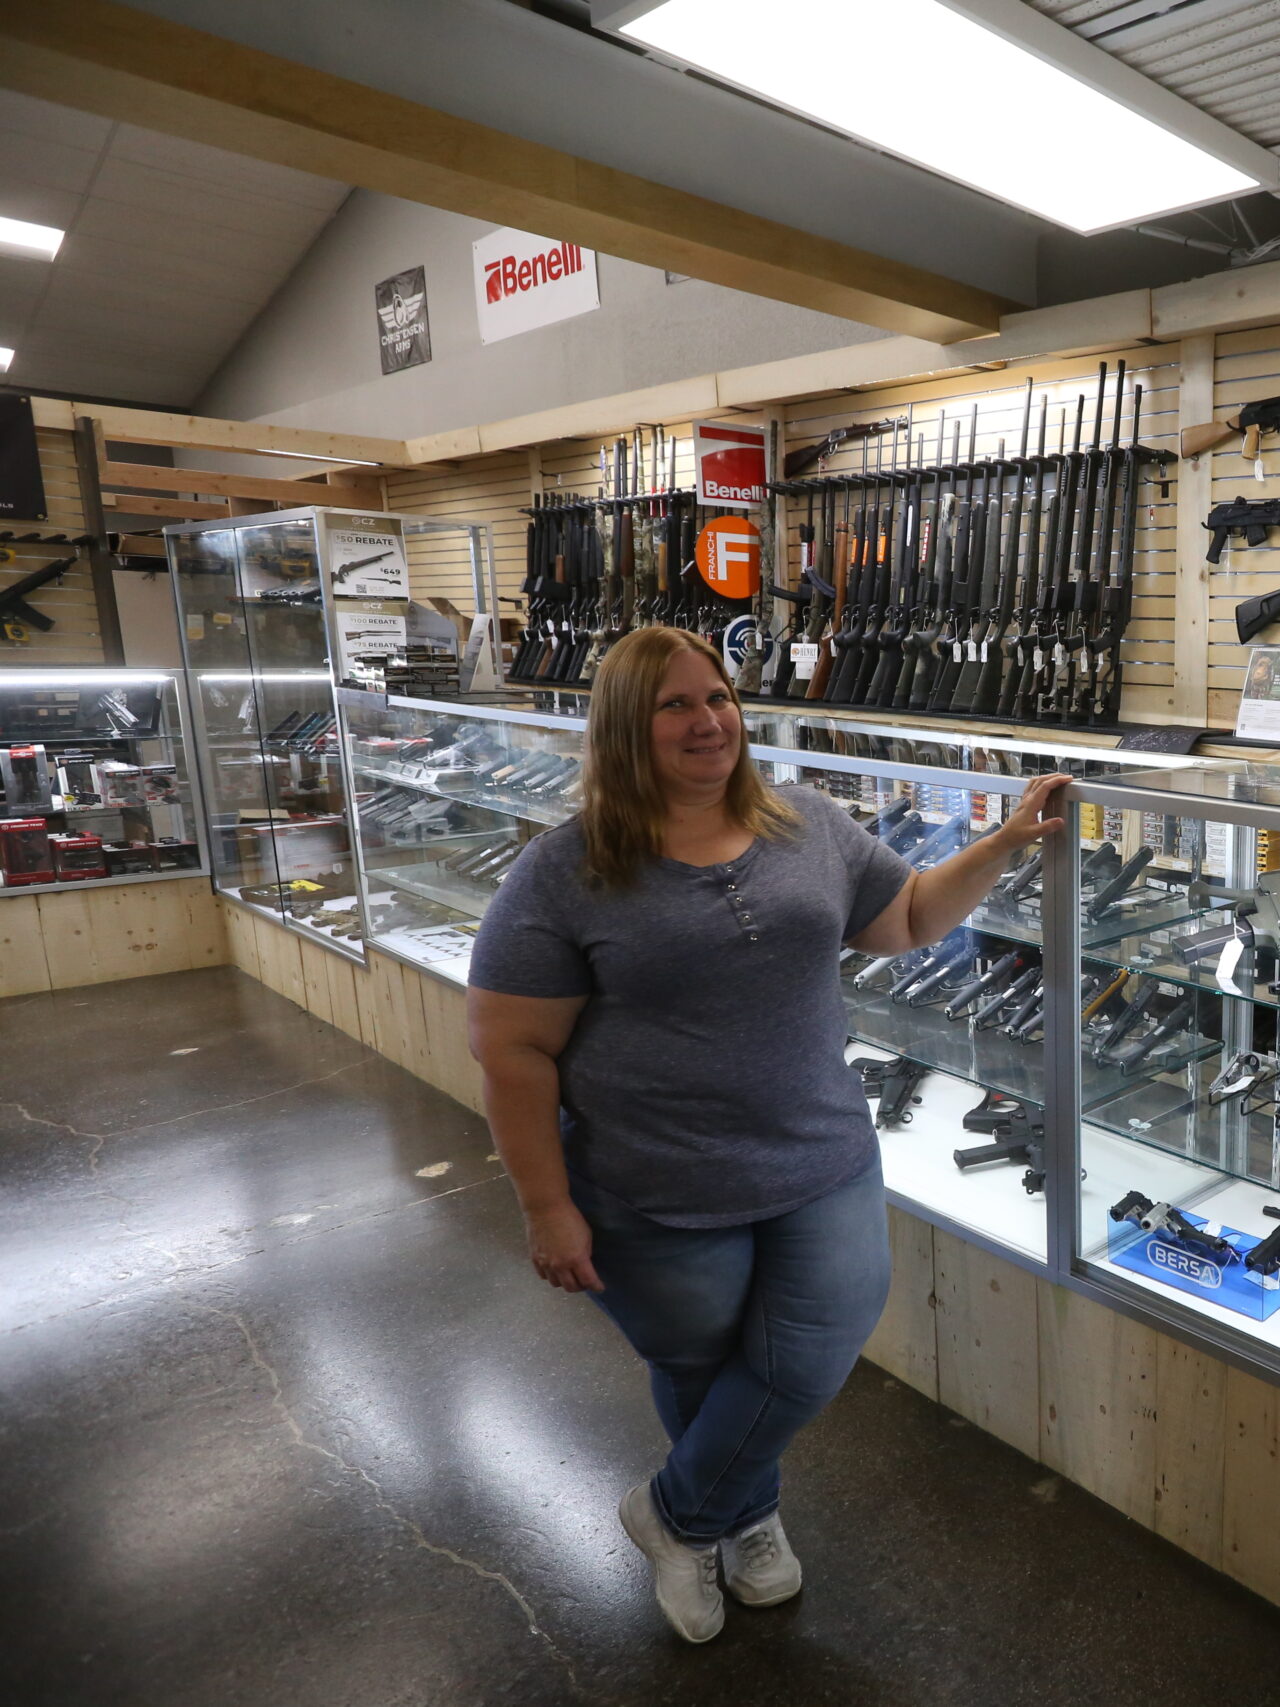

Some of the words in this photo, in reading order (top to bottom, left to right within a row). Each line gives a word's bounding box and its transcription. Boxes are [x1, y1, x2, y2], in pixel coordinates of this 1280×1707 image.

[502, 241, 582, 297] Benelli
[355, 536, 394, 546] REBATE
[707, 531, 716, 580] FRANCHI
[716, 531, 761, 580] F
[1155, 1246, 1215, 1282] BERSA
